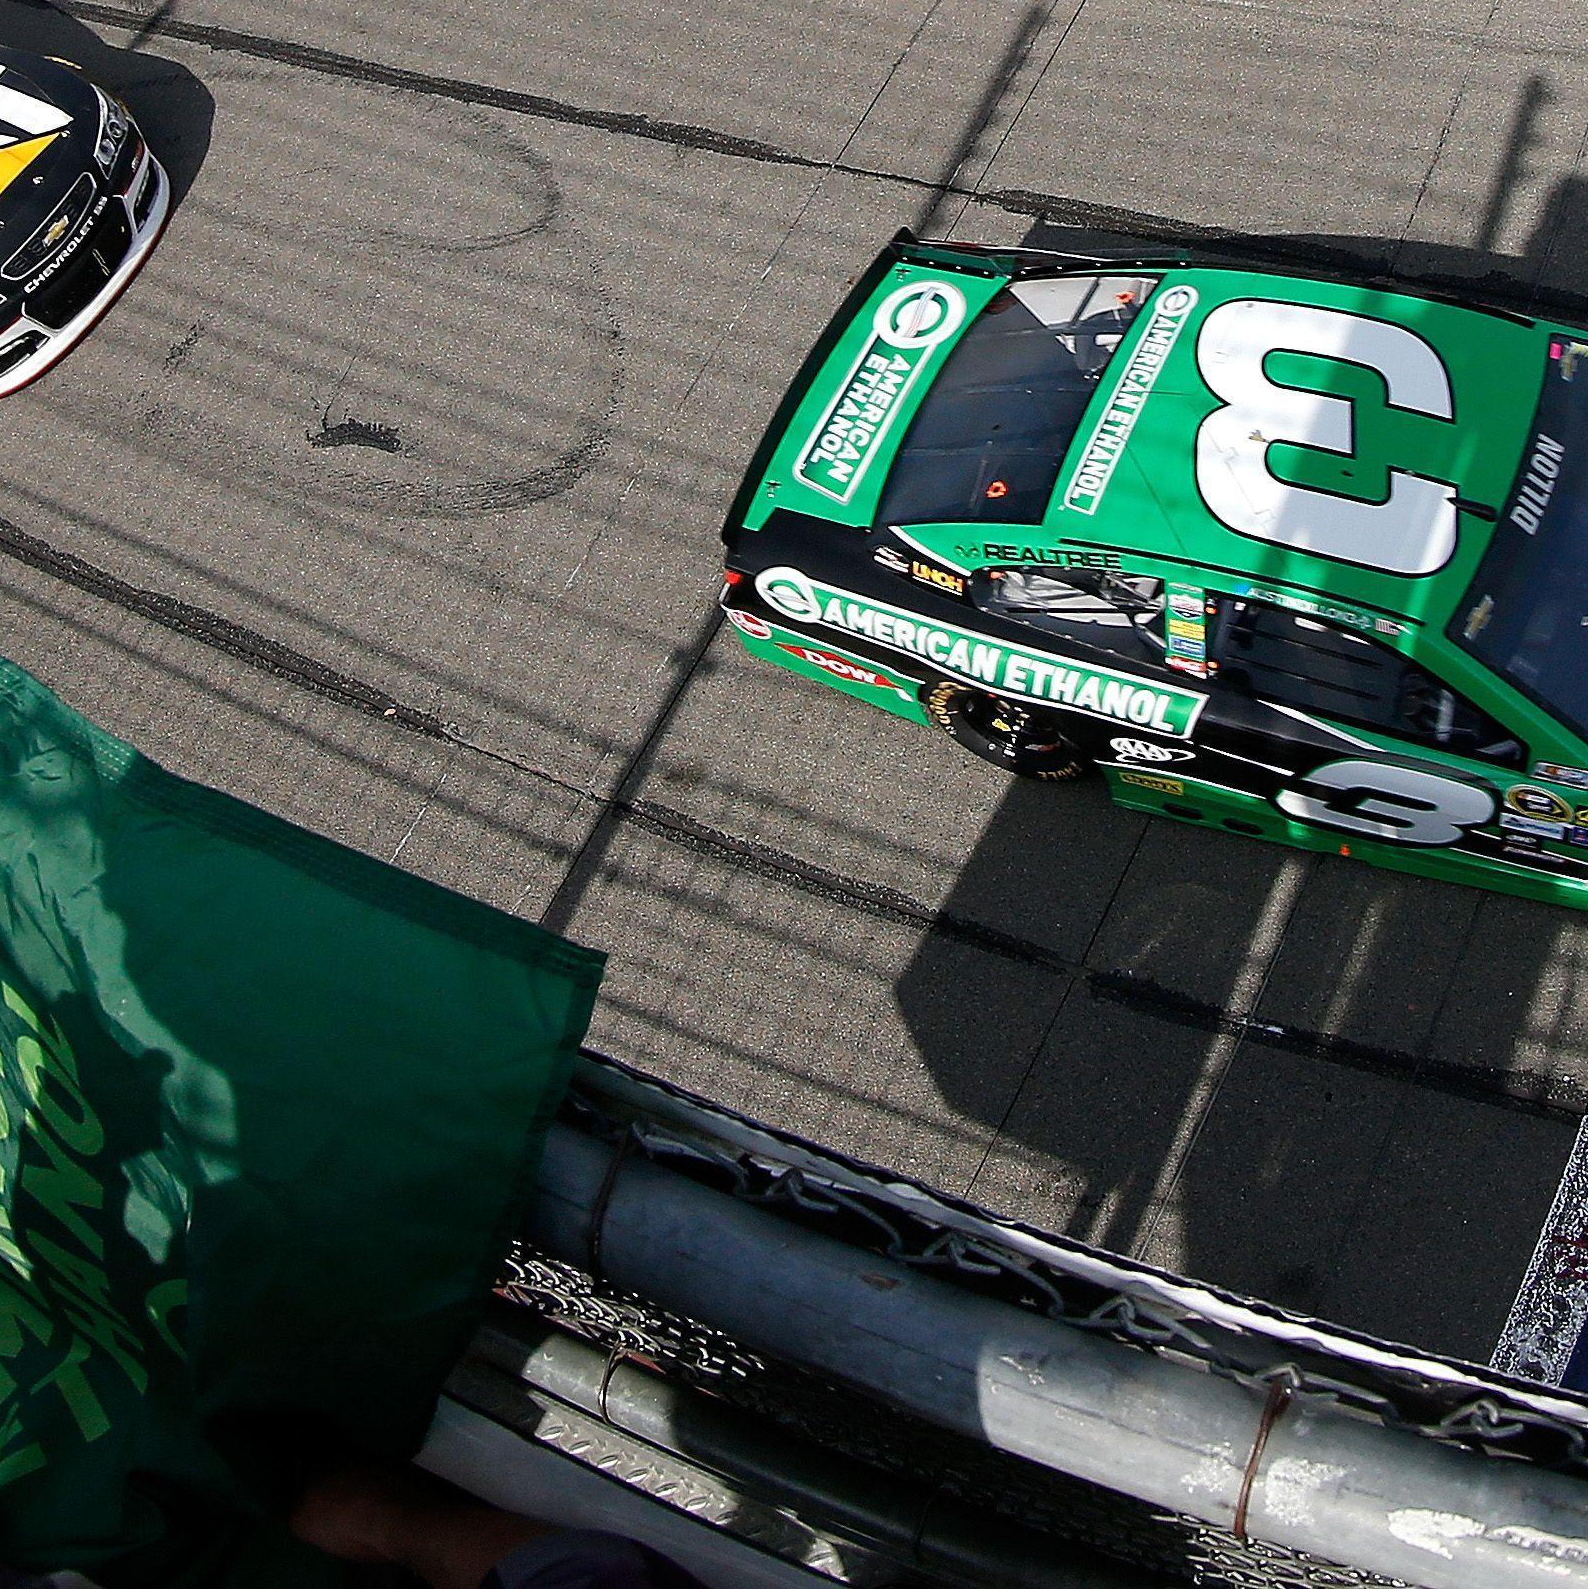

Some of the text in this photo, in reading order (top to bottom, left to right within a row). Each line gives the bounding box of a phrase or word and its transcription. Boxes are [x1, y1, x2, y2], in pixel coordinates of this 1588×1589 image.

[23, 216, 95, 294] CHEVROLET
[810, 353, 889, 465] ETHANOL
[827, 353, 911, 484] AMERICAN
[1074, 317, 1175, 503] AMERICAN ETHANOL
[1194, 296, 1460, 577] 3
[1509, 432, 1566, 536] DILLON
[984, 542, 1122, 571] REALTREE
[801, 647, 877, 684] DOW
[820, 597, 1001, 684] AMERICAN
[1002, 656, 1175, 731] ETHANOL
[1271, 758, 1500, 850] 3
